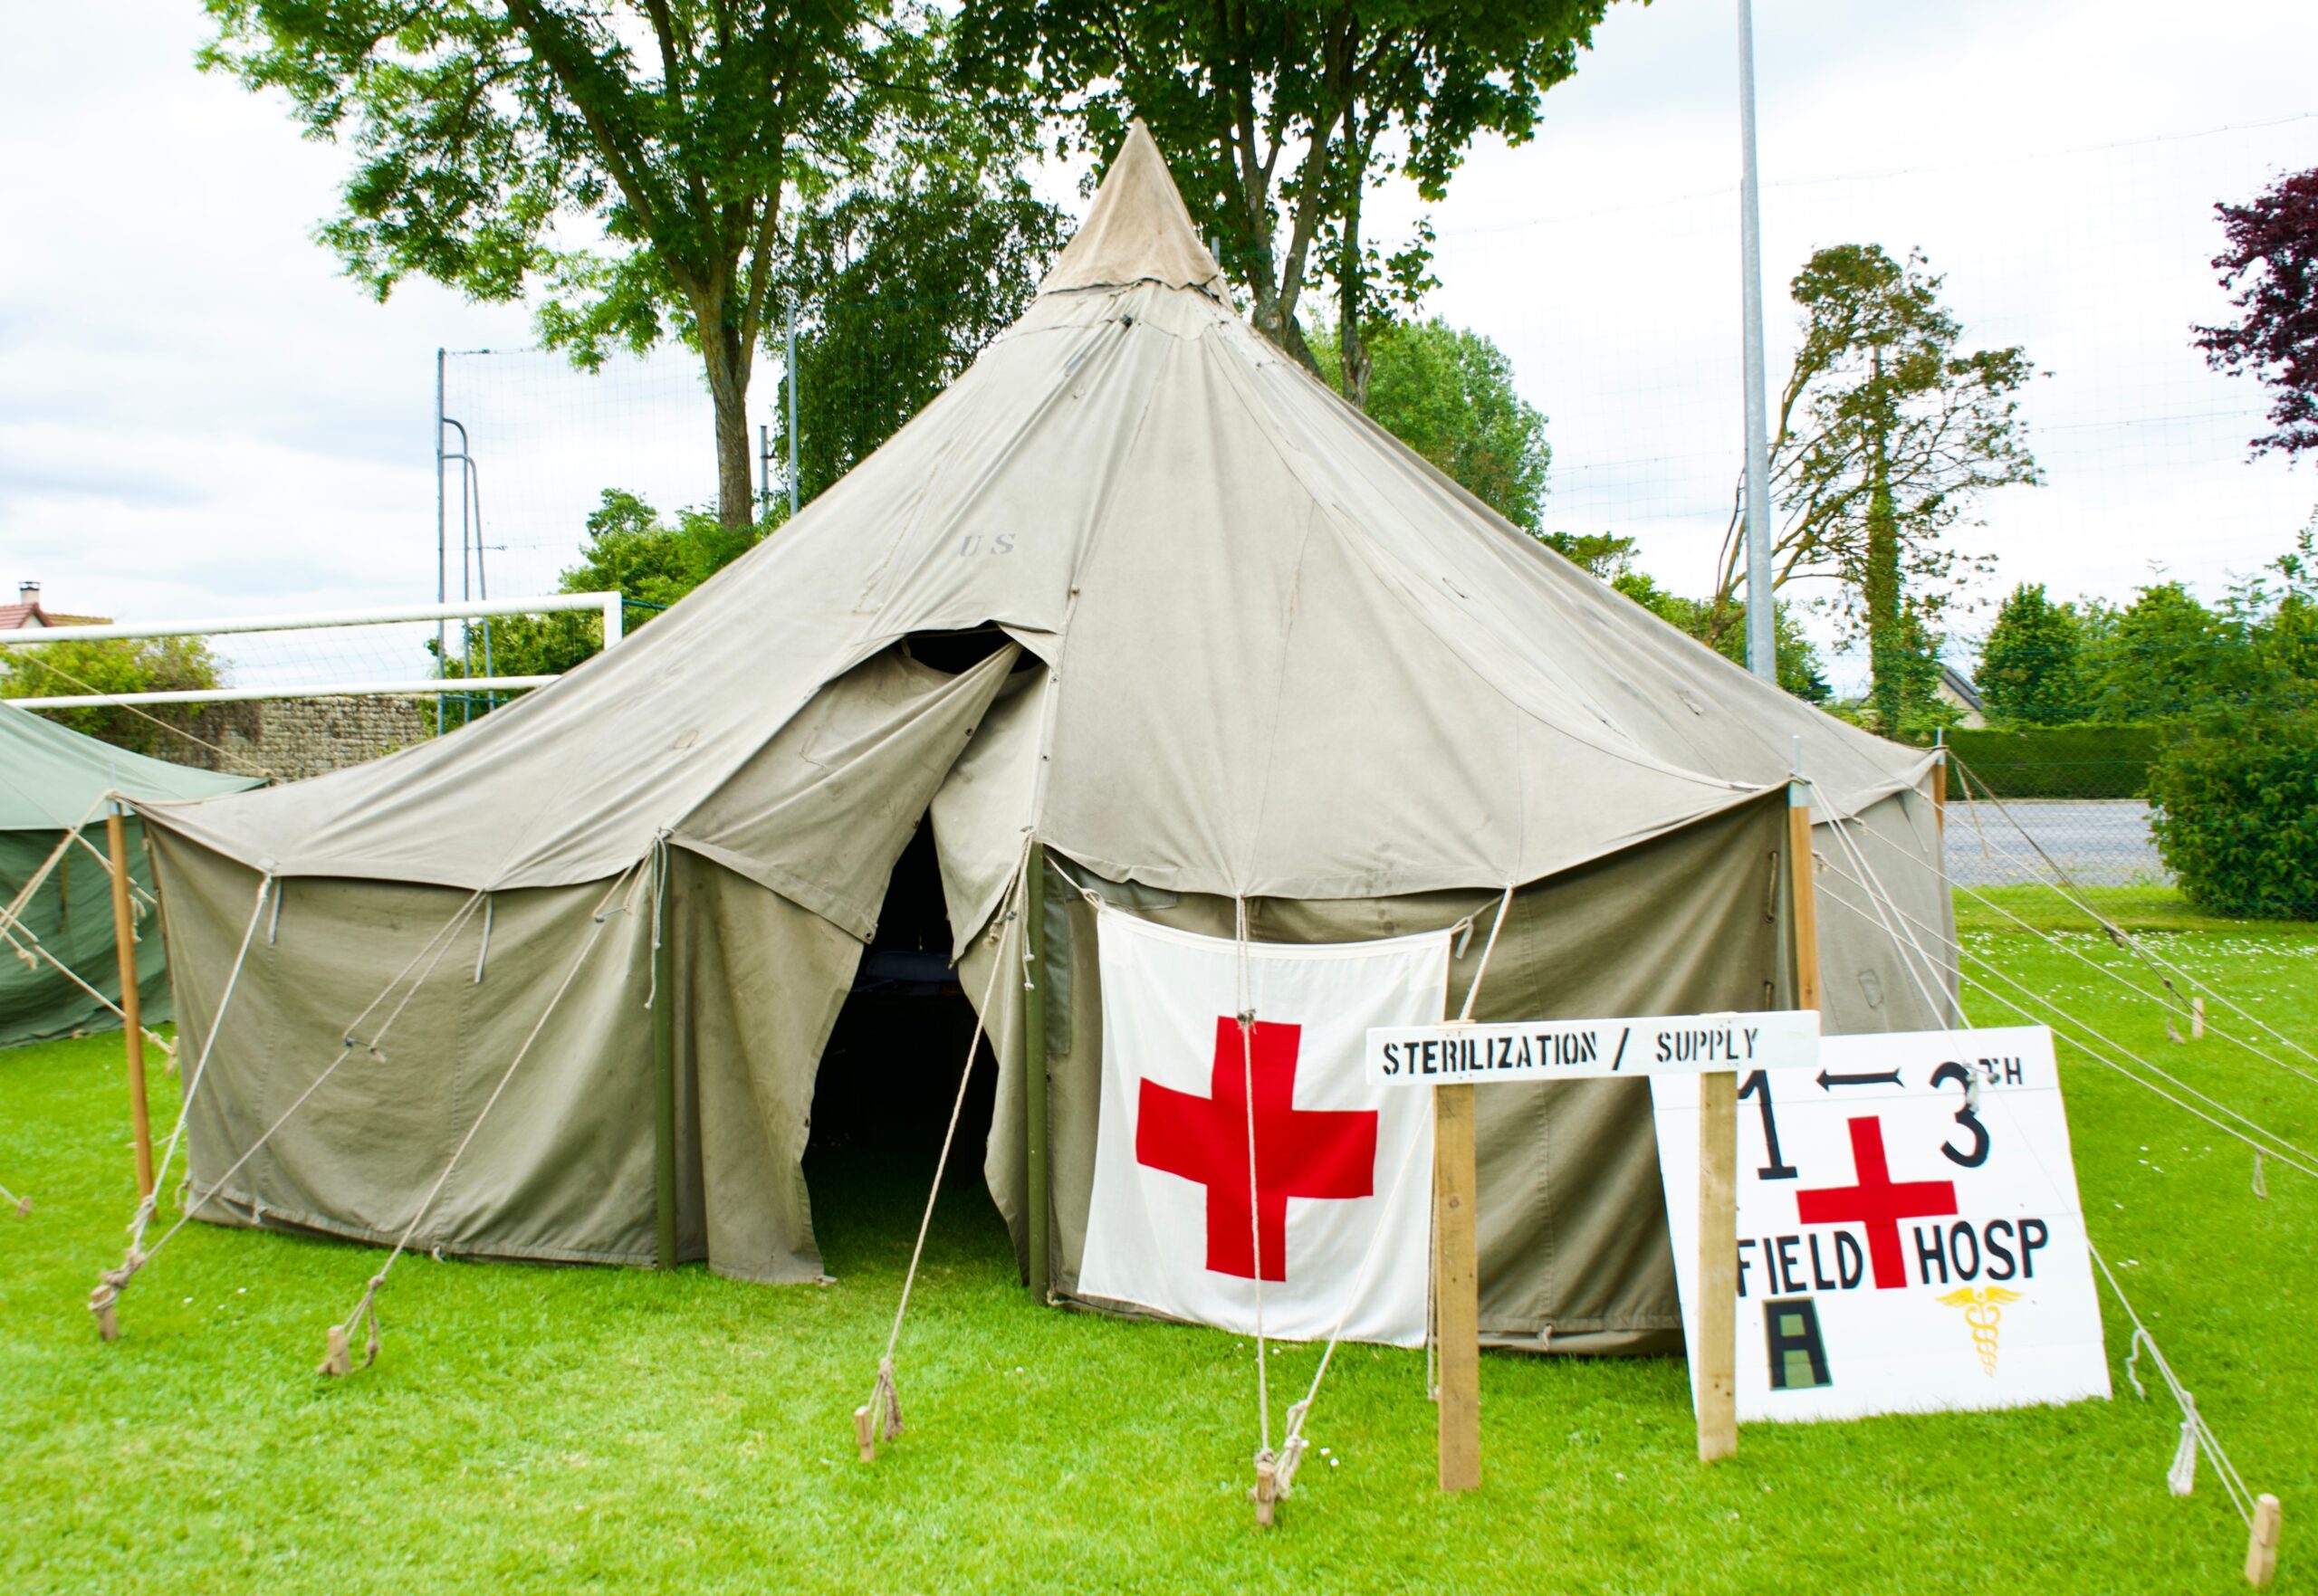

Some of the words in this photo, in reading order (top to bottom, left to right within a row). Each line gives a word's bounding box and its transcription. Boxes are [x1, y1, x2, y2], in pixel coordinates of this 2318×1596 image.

[1382, 1030, 1597, 1075] STERILIZATION
[1655, 1027, 1759, 1064] SUPPLY
[1736, 1229, 1863, 1297] FIELD
[1913, 1219, 2049, 1285] HOSP
